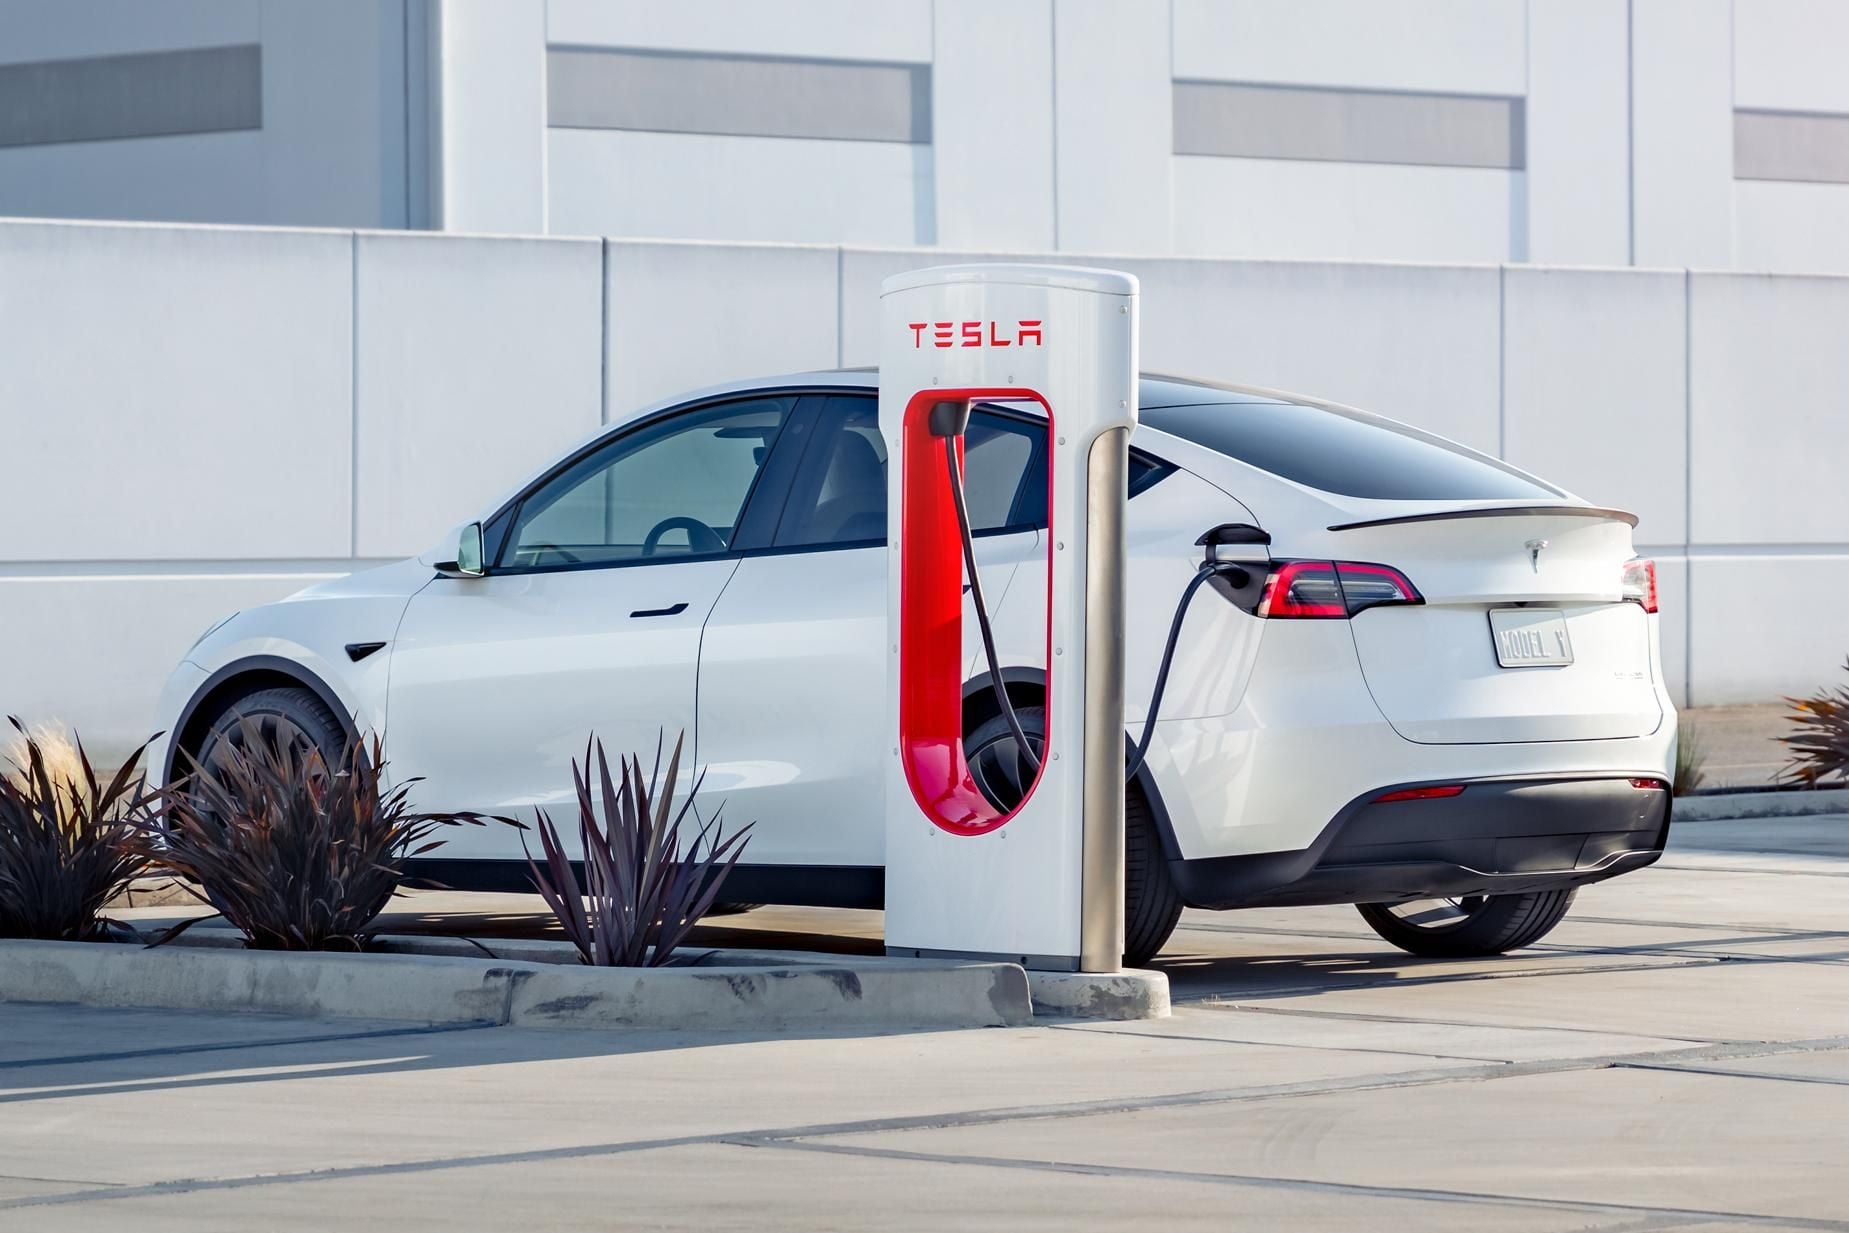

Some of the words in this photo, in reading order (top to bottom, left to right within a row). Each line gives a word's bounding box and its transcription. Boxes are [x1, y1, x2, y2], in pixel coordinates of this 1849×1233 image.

[908, 320, 1042, 348] TESLA
[1500, 629, 1551, 659] MODEL
[1554, 628, 1567, 658] Y
